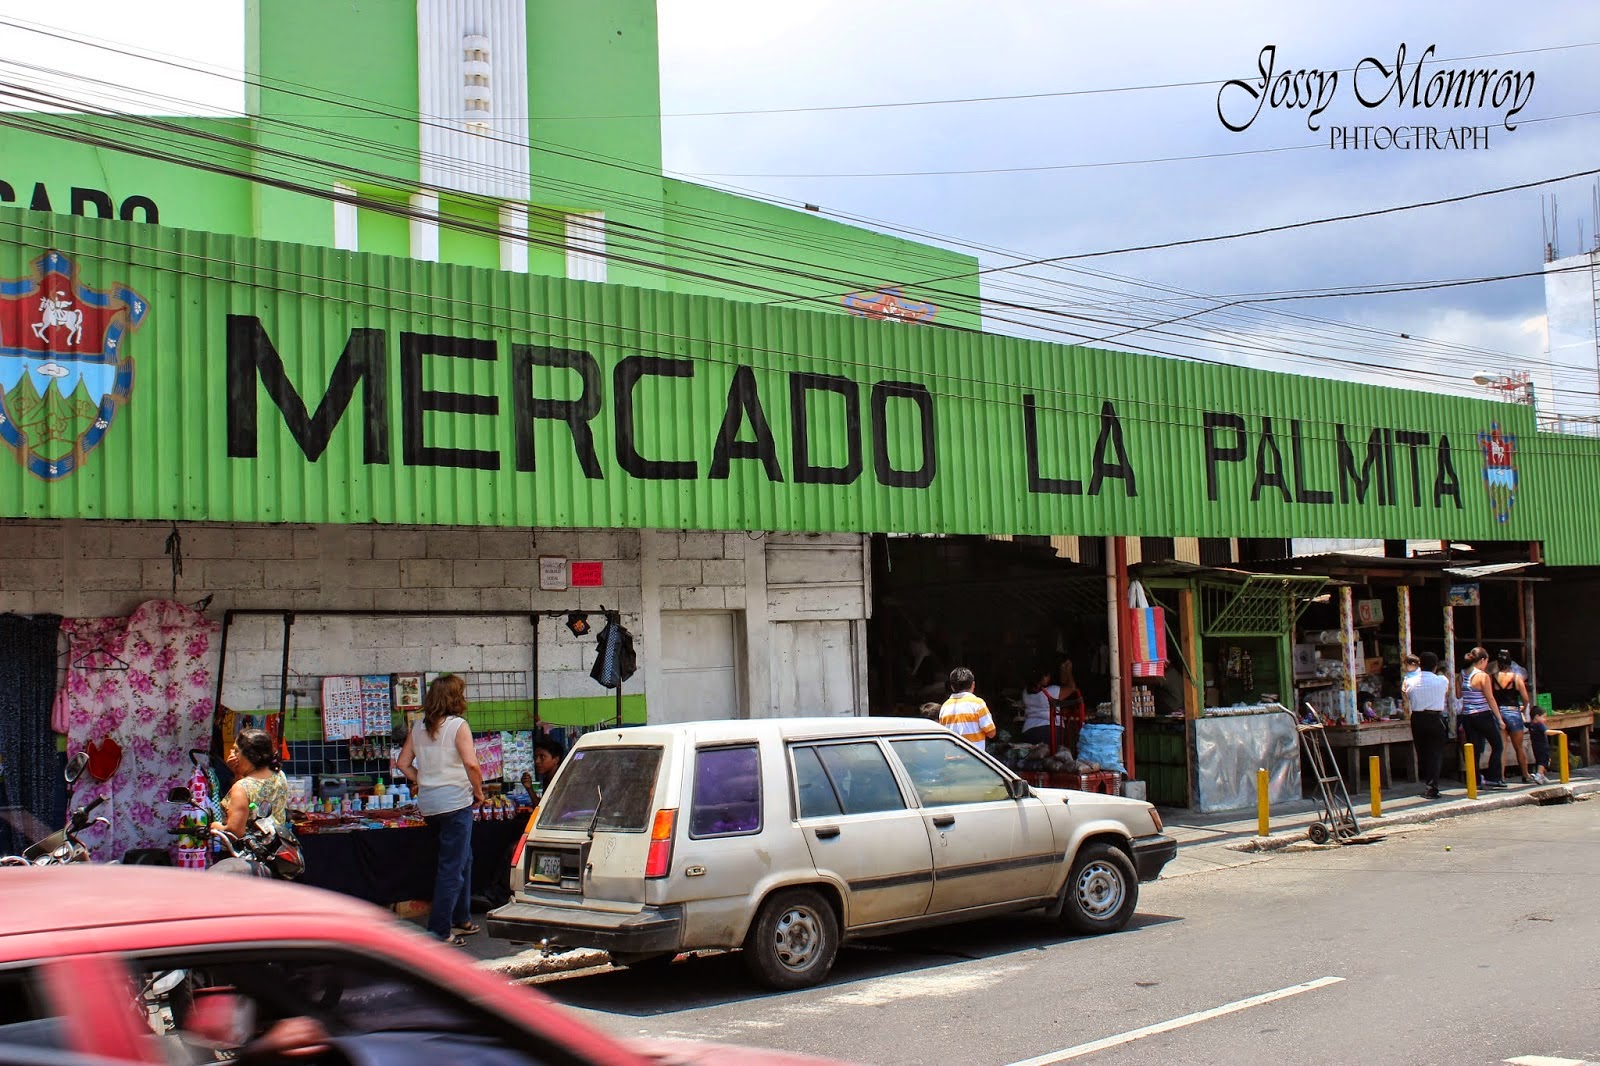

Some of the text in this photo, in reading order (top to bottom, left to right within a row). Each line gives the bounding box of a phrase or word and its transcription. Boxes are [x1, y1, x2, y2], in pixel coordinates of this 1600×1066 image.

[226, 313, 1464, 510] MERCADO LA PALMITA
